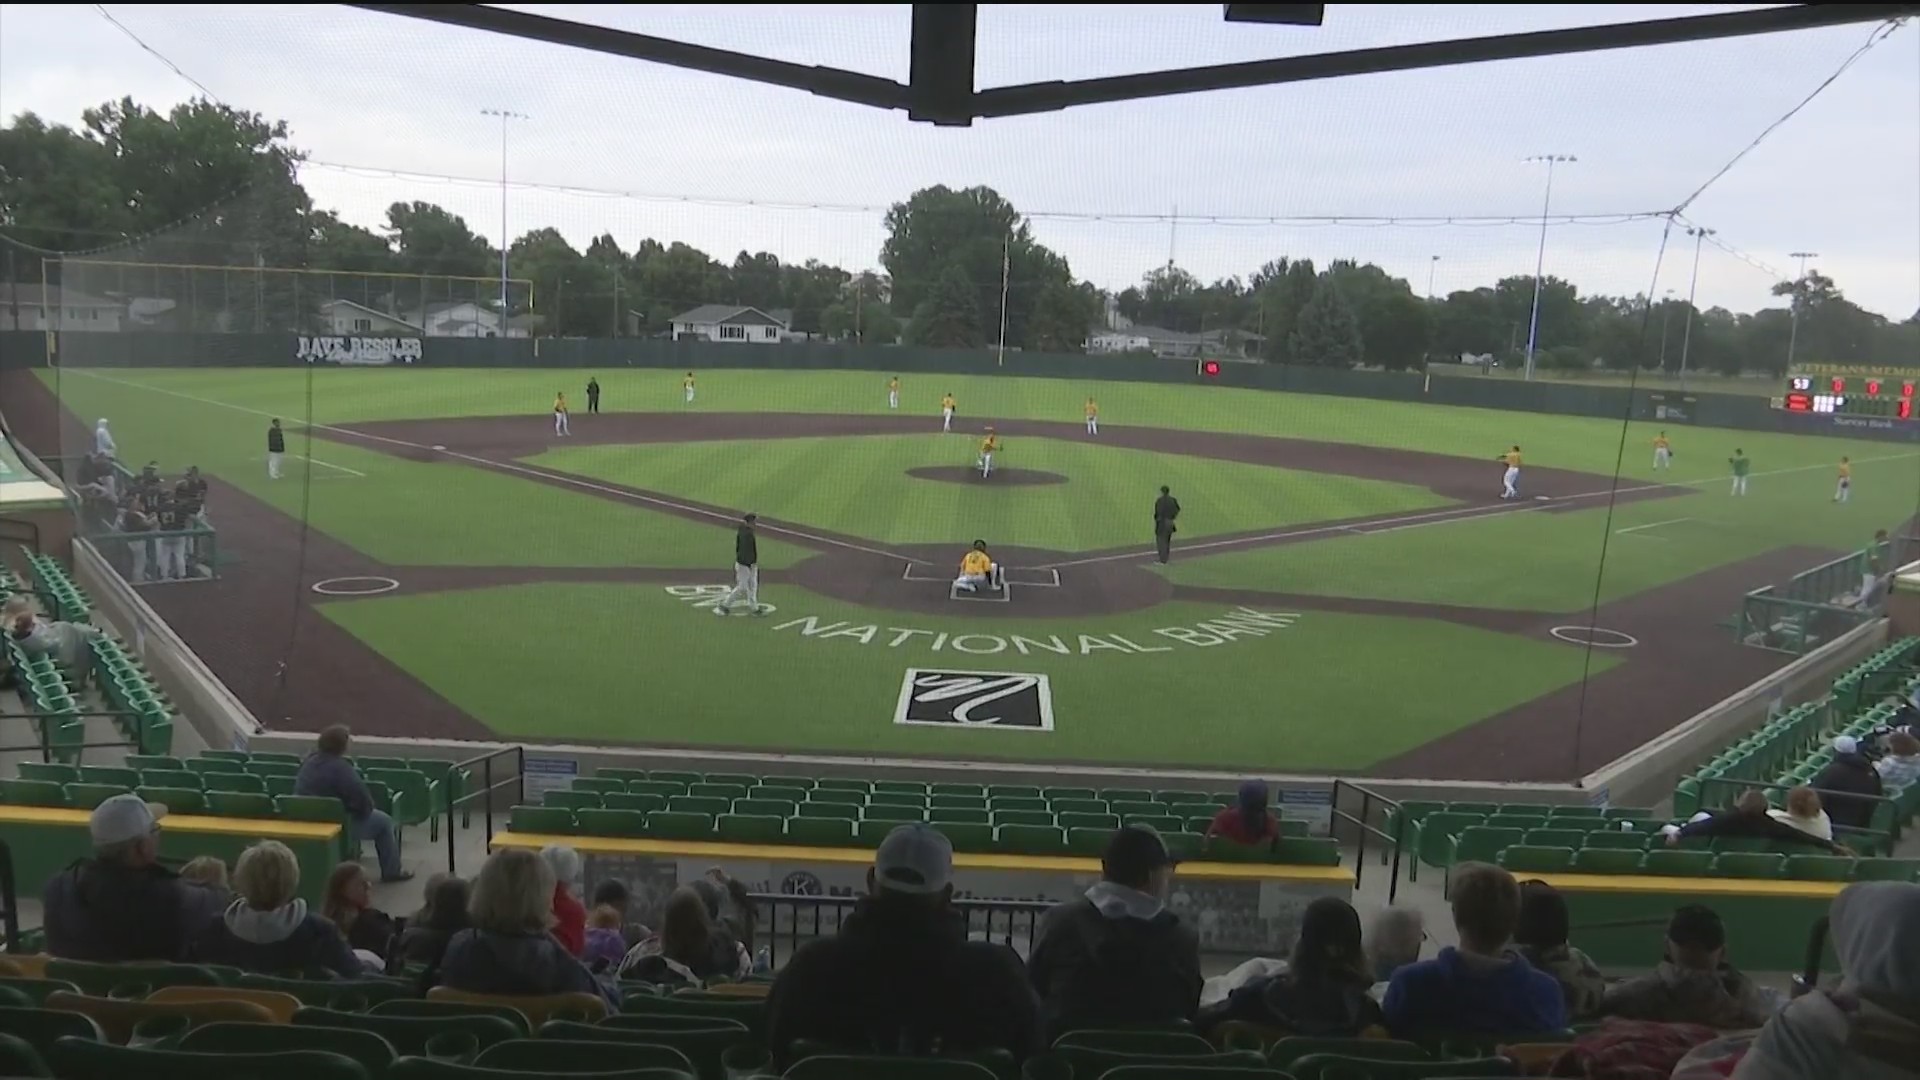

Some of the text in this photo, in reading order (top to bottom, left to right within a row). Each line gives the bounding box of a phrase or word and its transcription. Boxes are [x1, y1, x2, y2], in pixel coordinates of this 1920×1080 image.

[297, 336, 345, 358] DAVE
[772, 615, 1174, 655] NATIONAL
[1152, 605, 1301, 646] BANK
